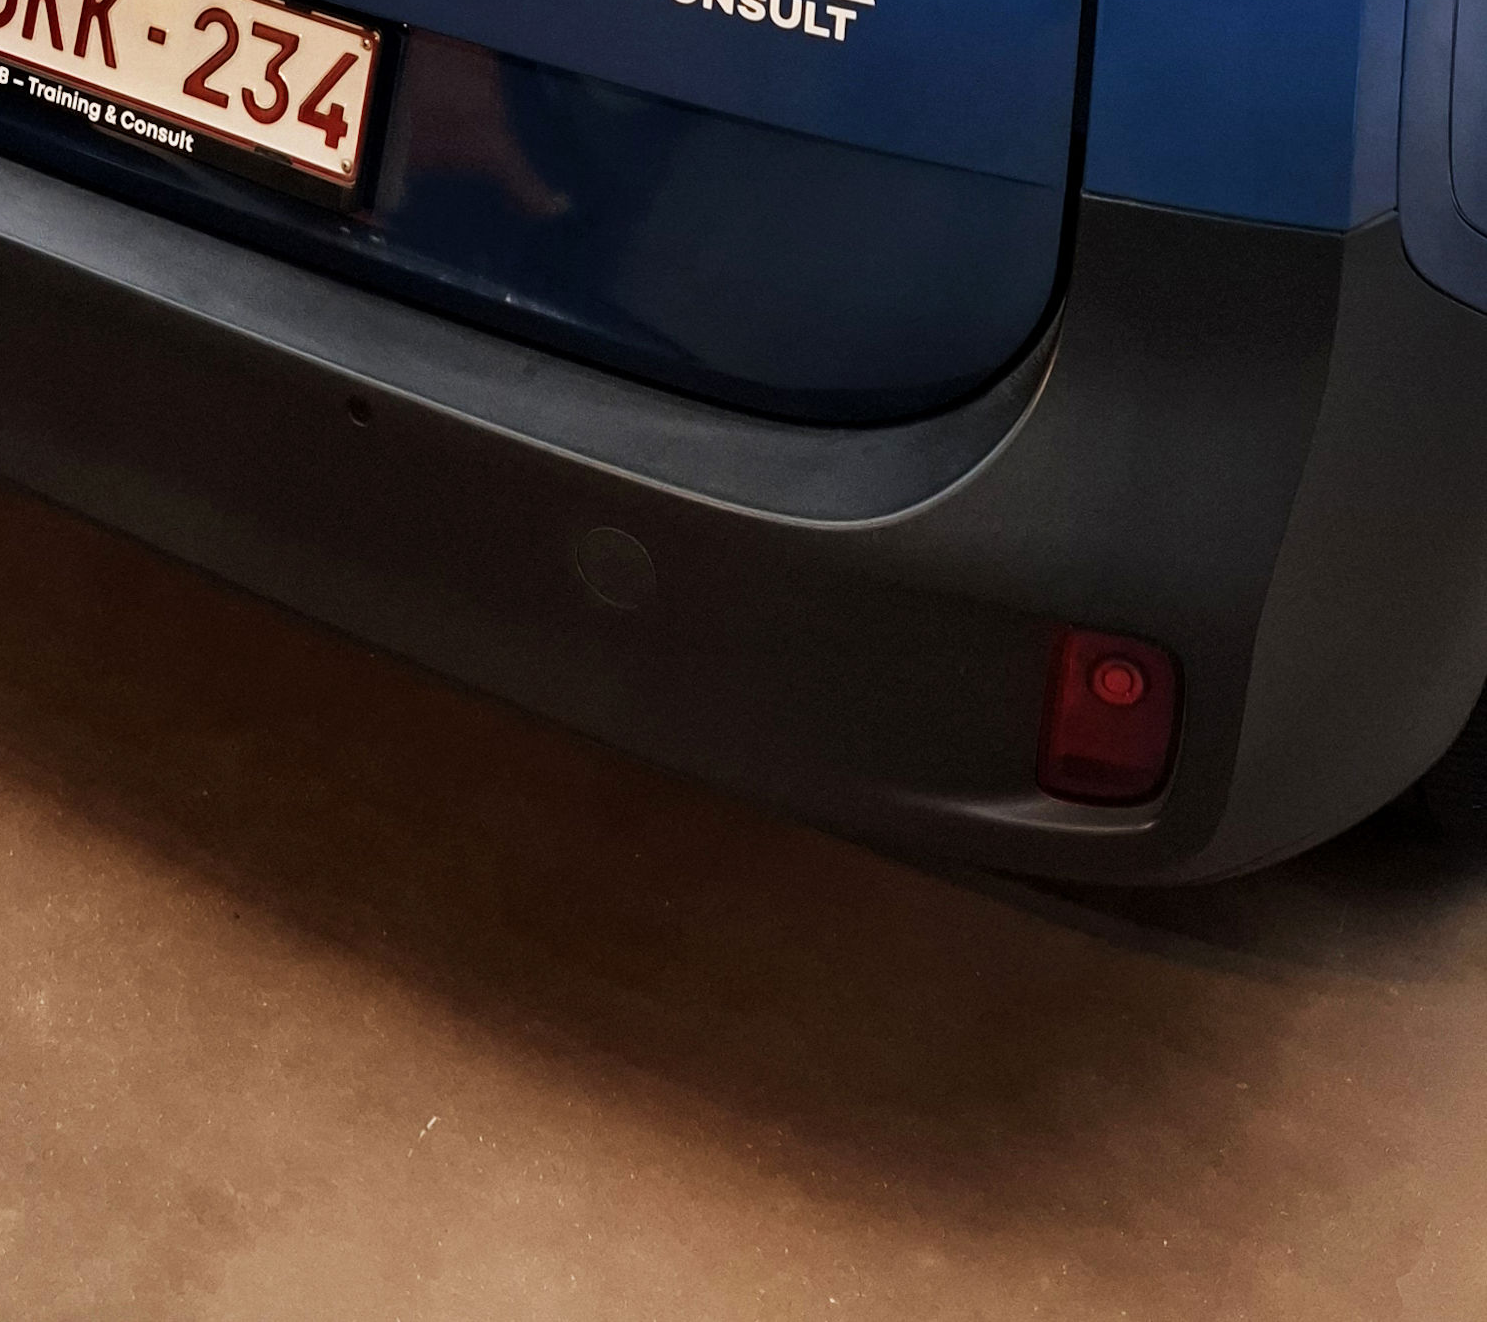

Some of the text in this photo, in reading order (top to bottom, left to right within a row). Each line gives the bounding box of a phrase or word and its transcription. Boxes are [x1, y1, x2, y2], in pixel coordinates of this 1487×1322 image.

[27, 75, 102, 123] Training
[104, 104, 117, 125] &
[120, 110, 195, 153] Consult
